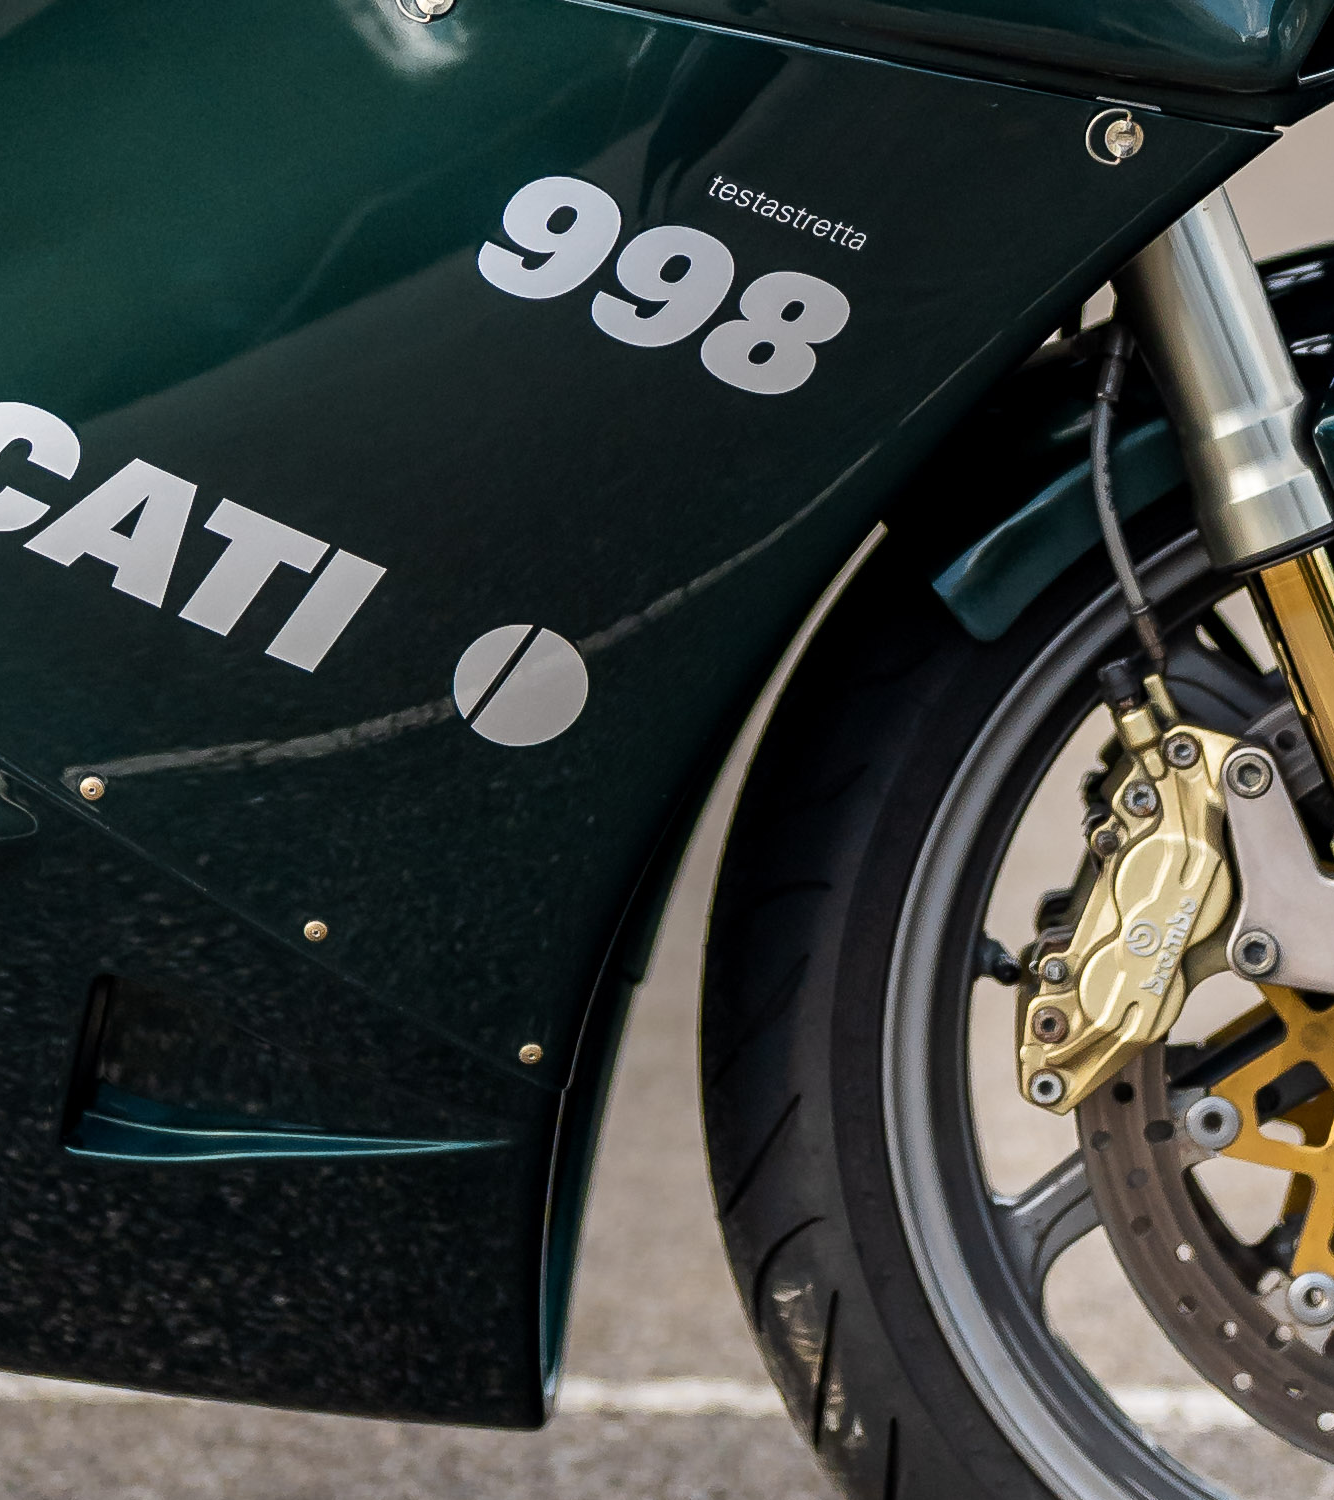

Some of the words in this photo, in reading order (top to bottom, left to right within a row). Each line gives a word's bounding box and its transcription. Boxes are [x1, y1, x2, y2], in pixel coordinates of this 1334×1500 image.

[708, 173, 869, 254] testastretta
[478, 176, 851, 395] 998
[1139, 897, 1197, 996] brembo
